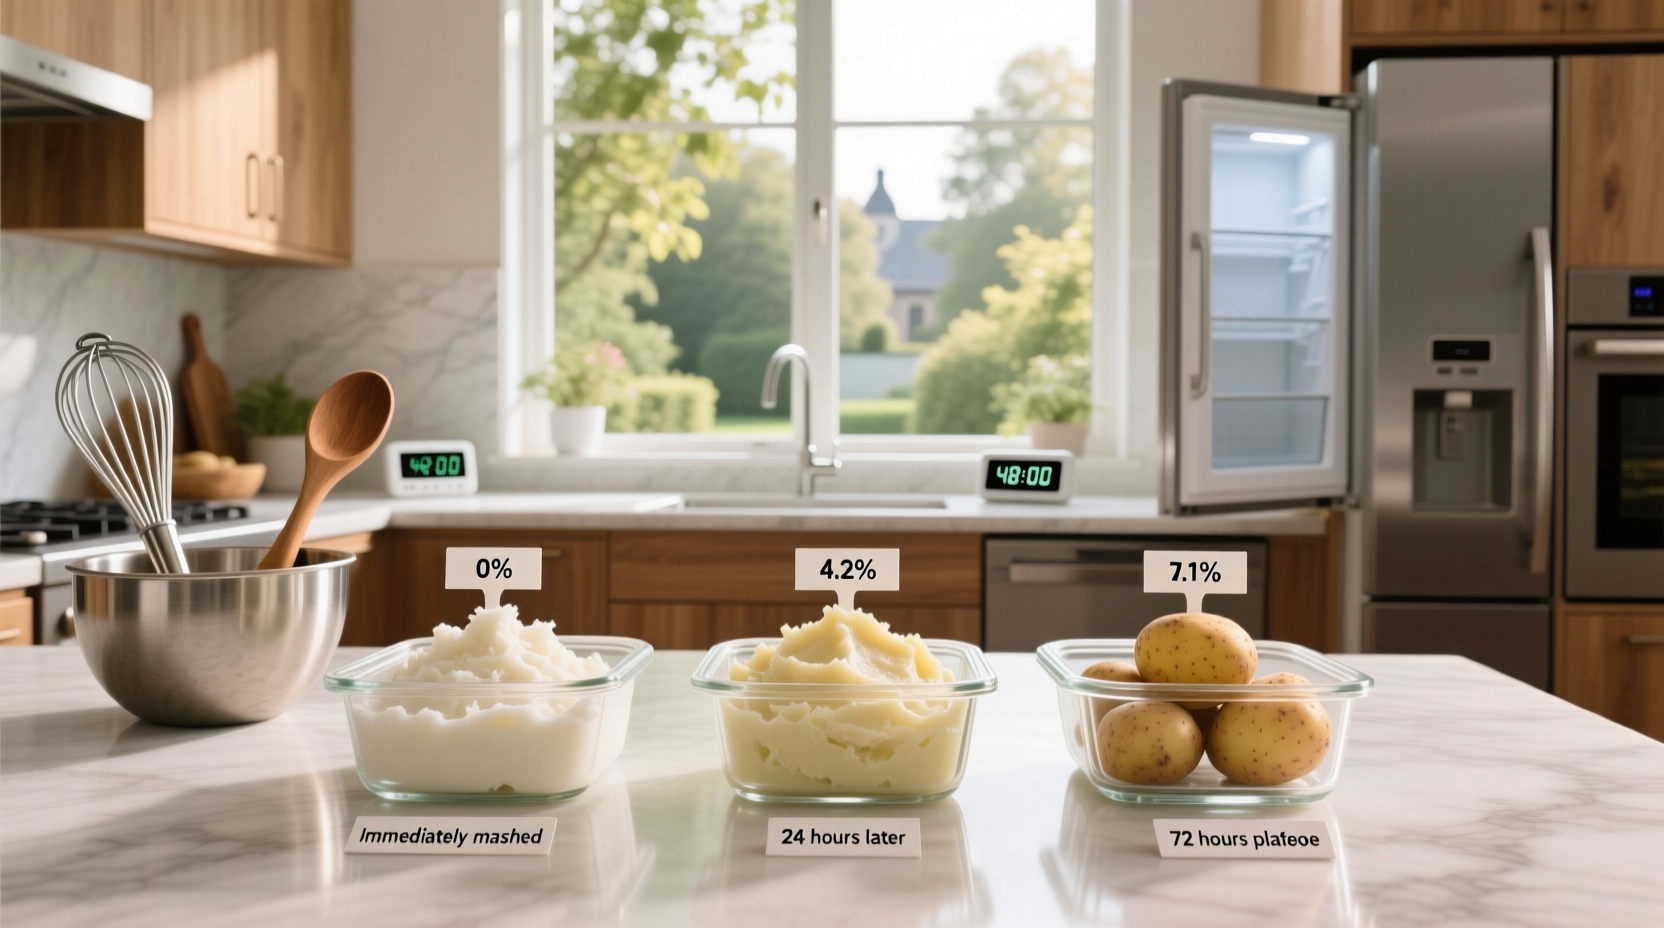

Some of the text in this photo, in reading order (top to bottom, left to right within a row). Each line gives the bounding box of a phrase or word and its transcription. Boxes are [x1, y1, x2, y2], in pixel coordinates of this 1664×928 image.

[996, 465, 1053, 487] 48:00
[476, 557, 513, 579] 0%
[819, 558, 877, 581] 4.2%
[1169, 561, 1222, 583] 7.1%
[359, 827, 544, 848] Immediately mashed
[781, 828, 906, 845] 24 hours later
[1169, 830, 1194, 847] 72
[1198, 830, 1248, 847] hours
